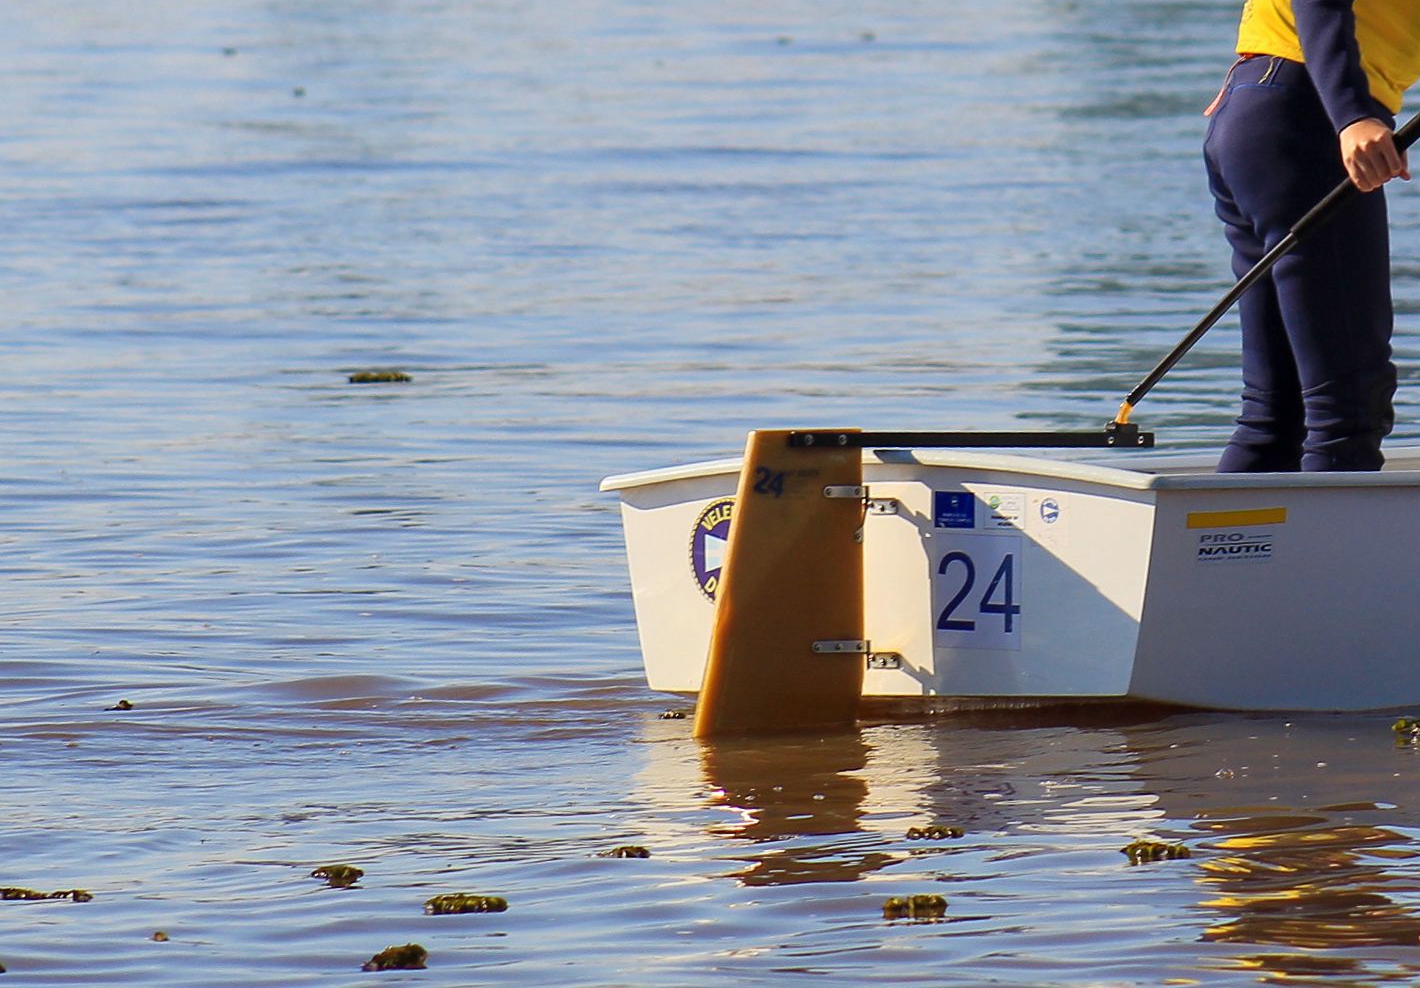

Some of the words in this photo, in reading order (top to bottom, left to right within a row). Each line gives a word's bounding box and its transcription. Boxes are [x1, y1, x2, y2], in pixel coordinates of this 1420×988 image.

[754, 466, 785, 498] 24
[1201, 533, 1245, 544] PRO
[1198, 544, 1273, 555] NAUTIC
[936, 551, 1020, 633] 24
